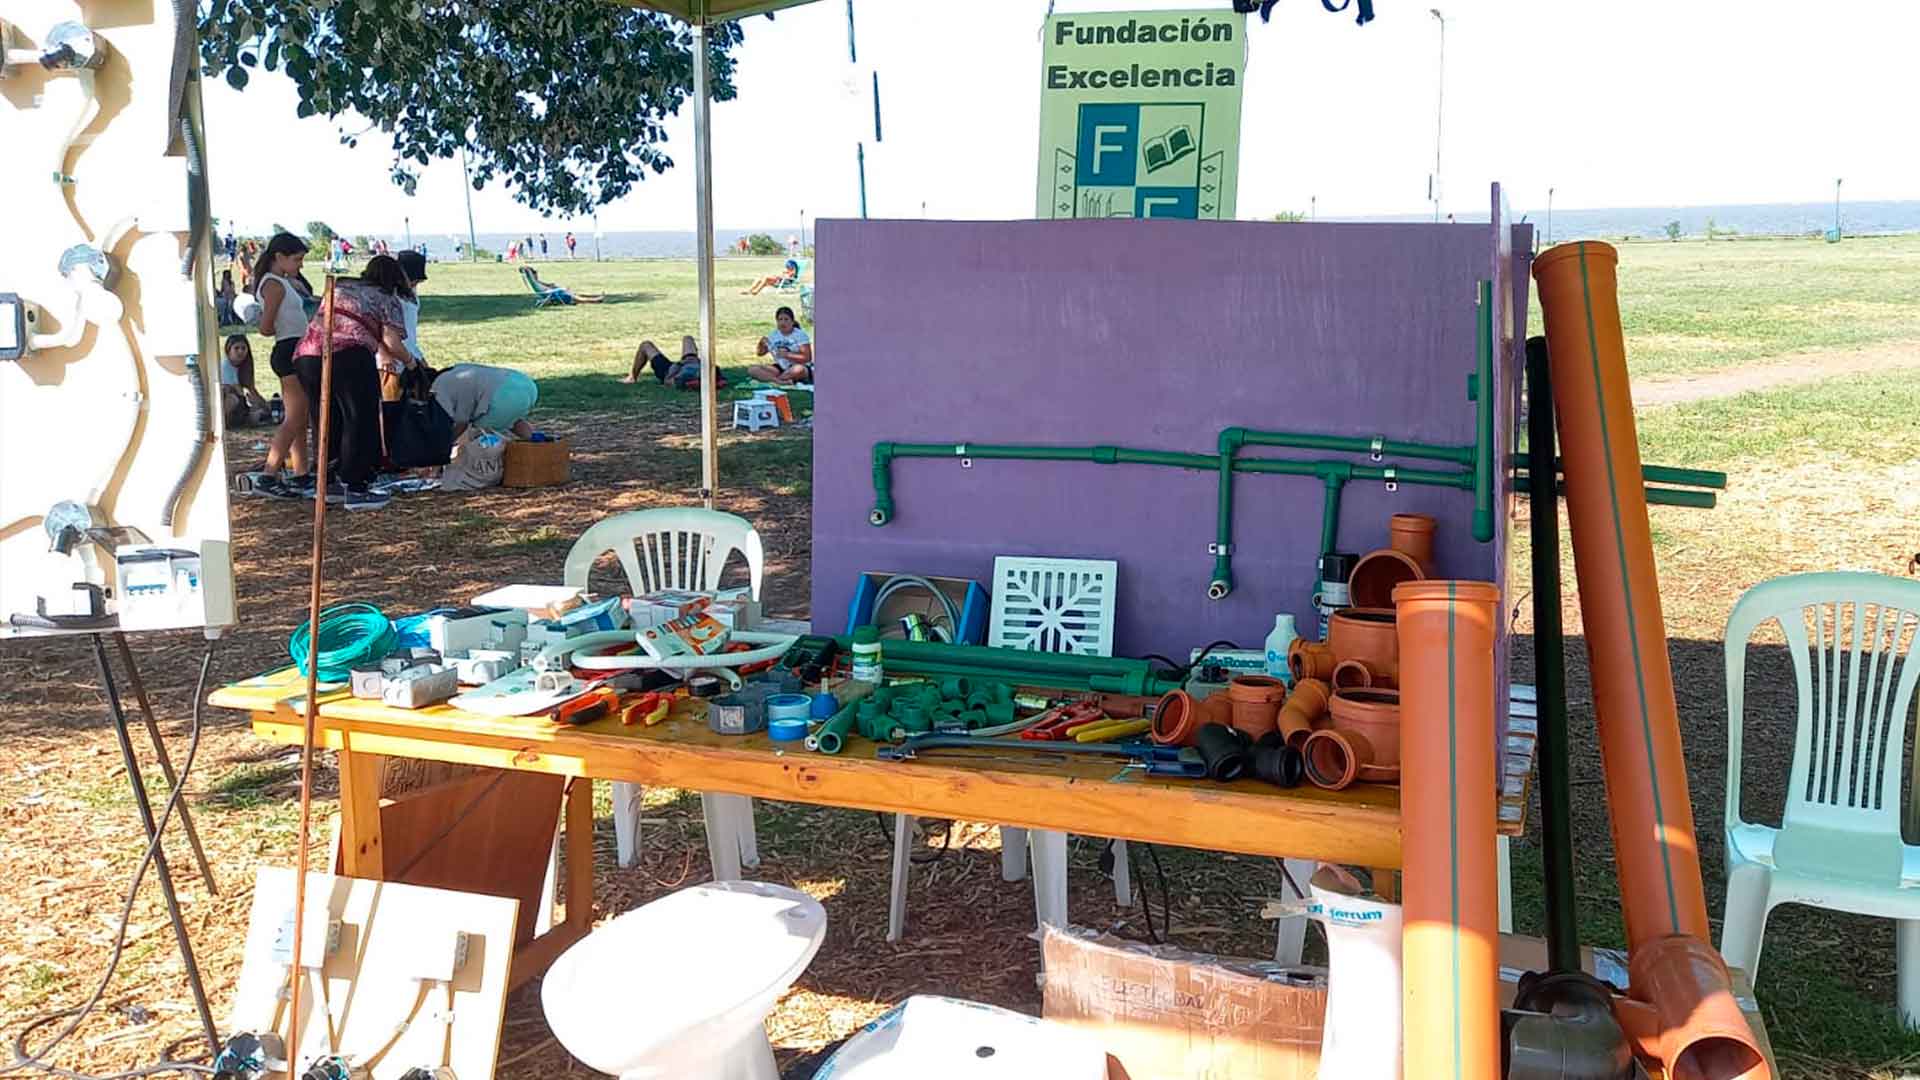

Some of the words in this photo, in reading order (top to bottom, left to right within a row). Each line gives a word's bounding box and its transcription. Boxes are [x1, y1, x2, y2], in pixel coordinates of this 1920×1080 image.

[1055, 18, 1233, 45] Fundación
[1047, 62, 1236, 89] Excelencia
[1092, 125, 1127, 175] F
